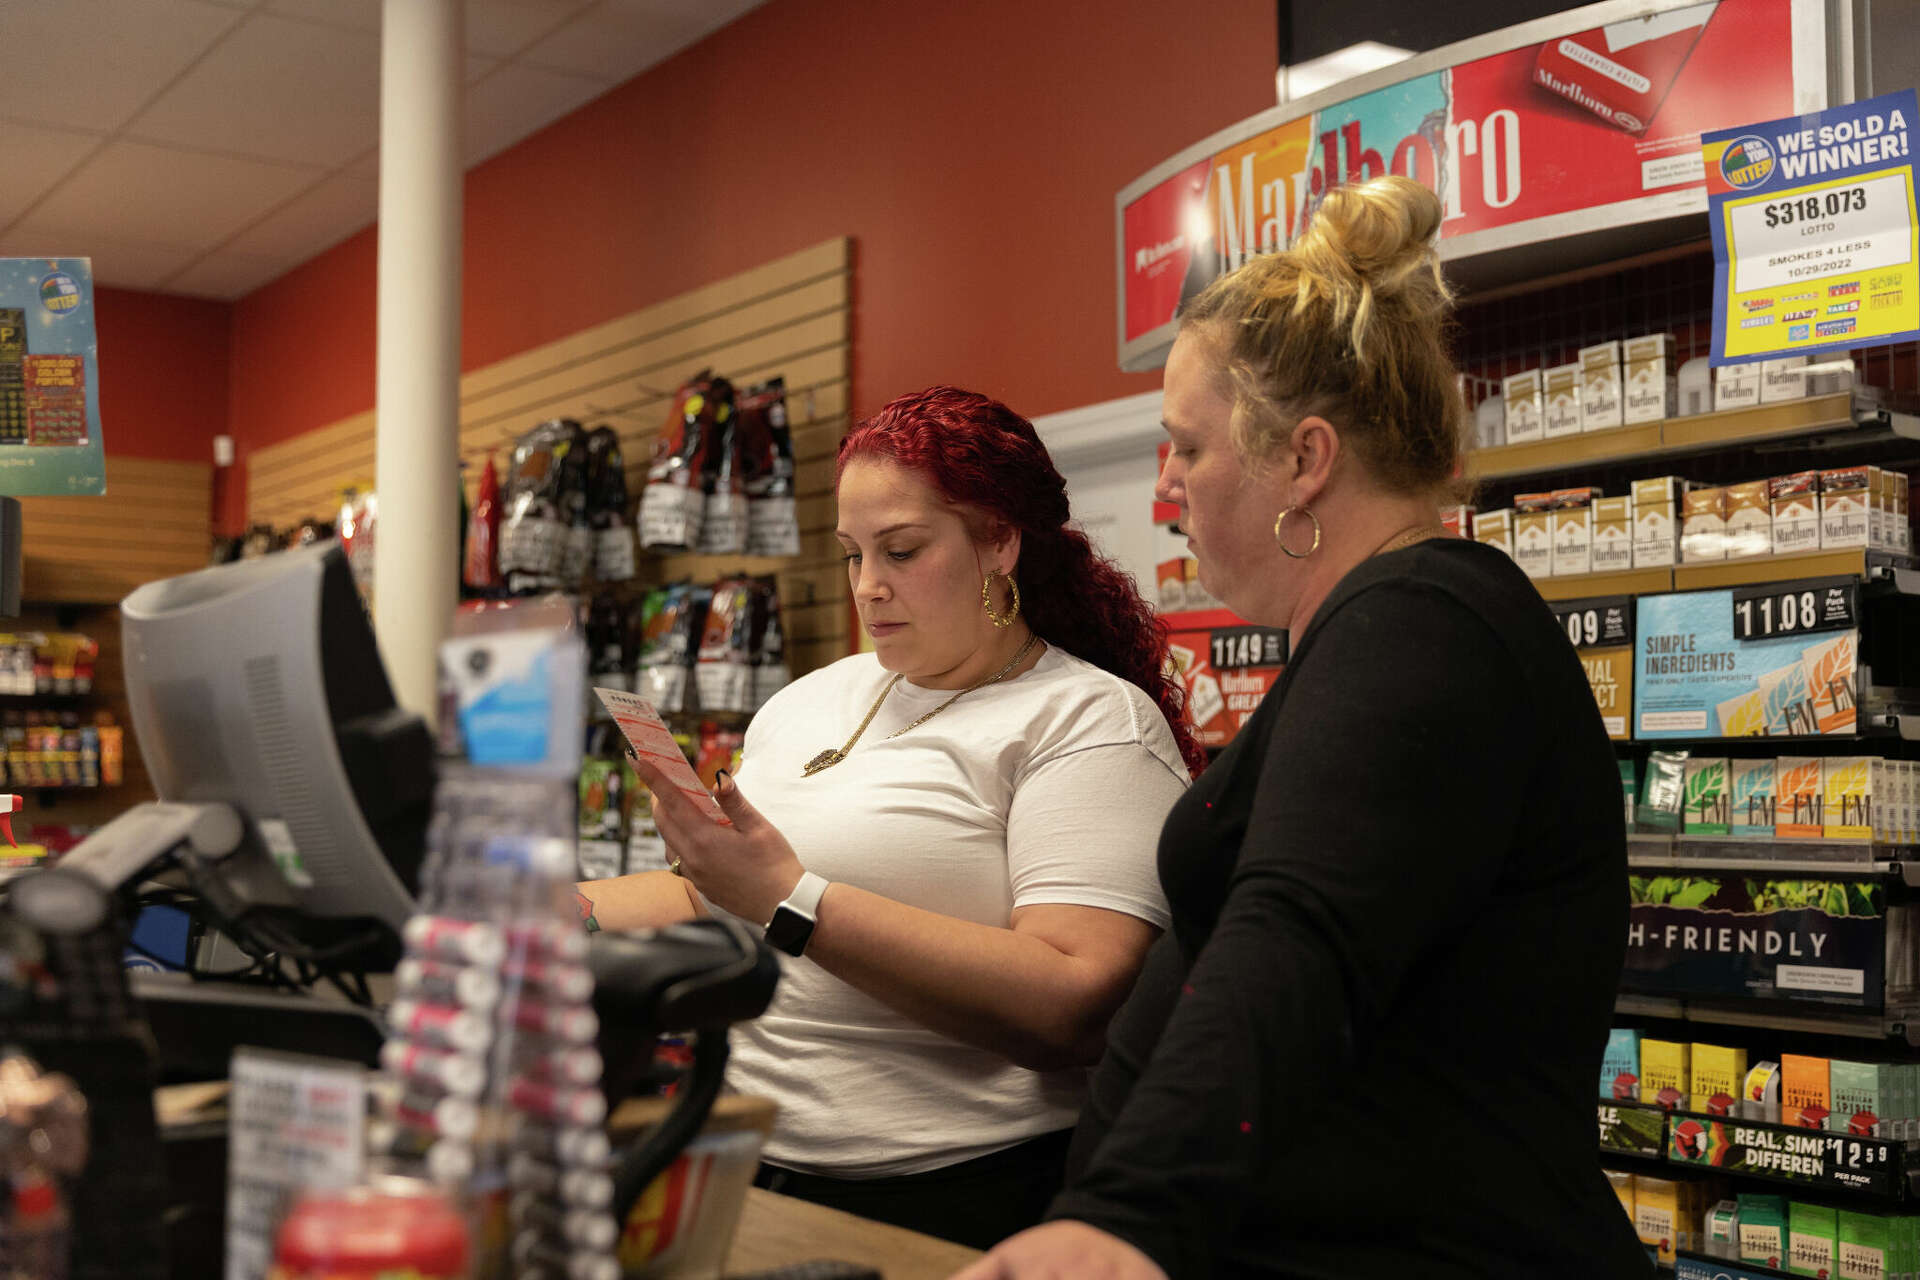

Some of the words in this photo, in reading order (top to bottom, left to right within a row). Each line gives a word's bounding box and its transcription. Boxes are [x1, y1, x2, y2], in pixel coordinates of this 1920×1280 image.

[1539, 69, 1613, 117] Marlboro
[1777, 130, 1815, 155] WE
[1819, 115, 1884, 146] SOLD
[1889, 109, 1907, 131] A
[1779, 131, 1909, 180] WINNER!
[1765, 188, 1867, 229] $318,073
[1801, 222, 1835, 236] LOTTO
[1768, 249, 1823, 267] SMOKES
[1837, 240, 1872, 254] LESS
[1789, 258, 1852, 278] 10/29/2022
[1646, 633, 1697, 654] SIMPLE
[1645, 652, 1736, 675] INGREDIENTS
[1628, 923, 1827, 958] H-FRIENDLY
[1735, 1127, 1782, 1151] REAL.
[1834, 1172, 1850, 1181] PER
[1851, 1174, 1872, 1184] PACK
